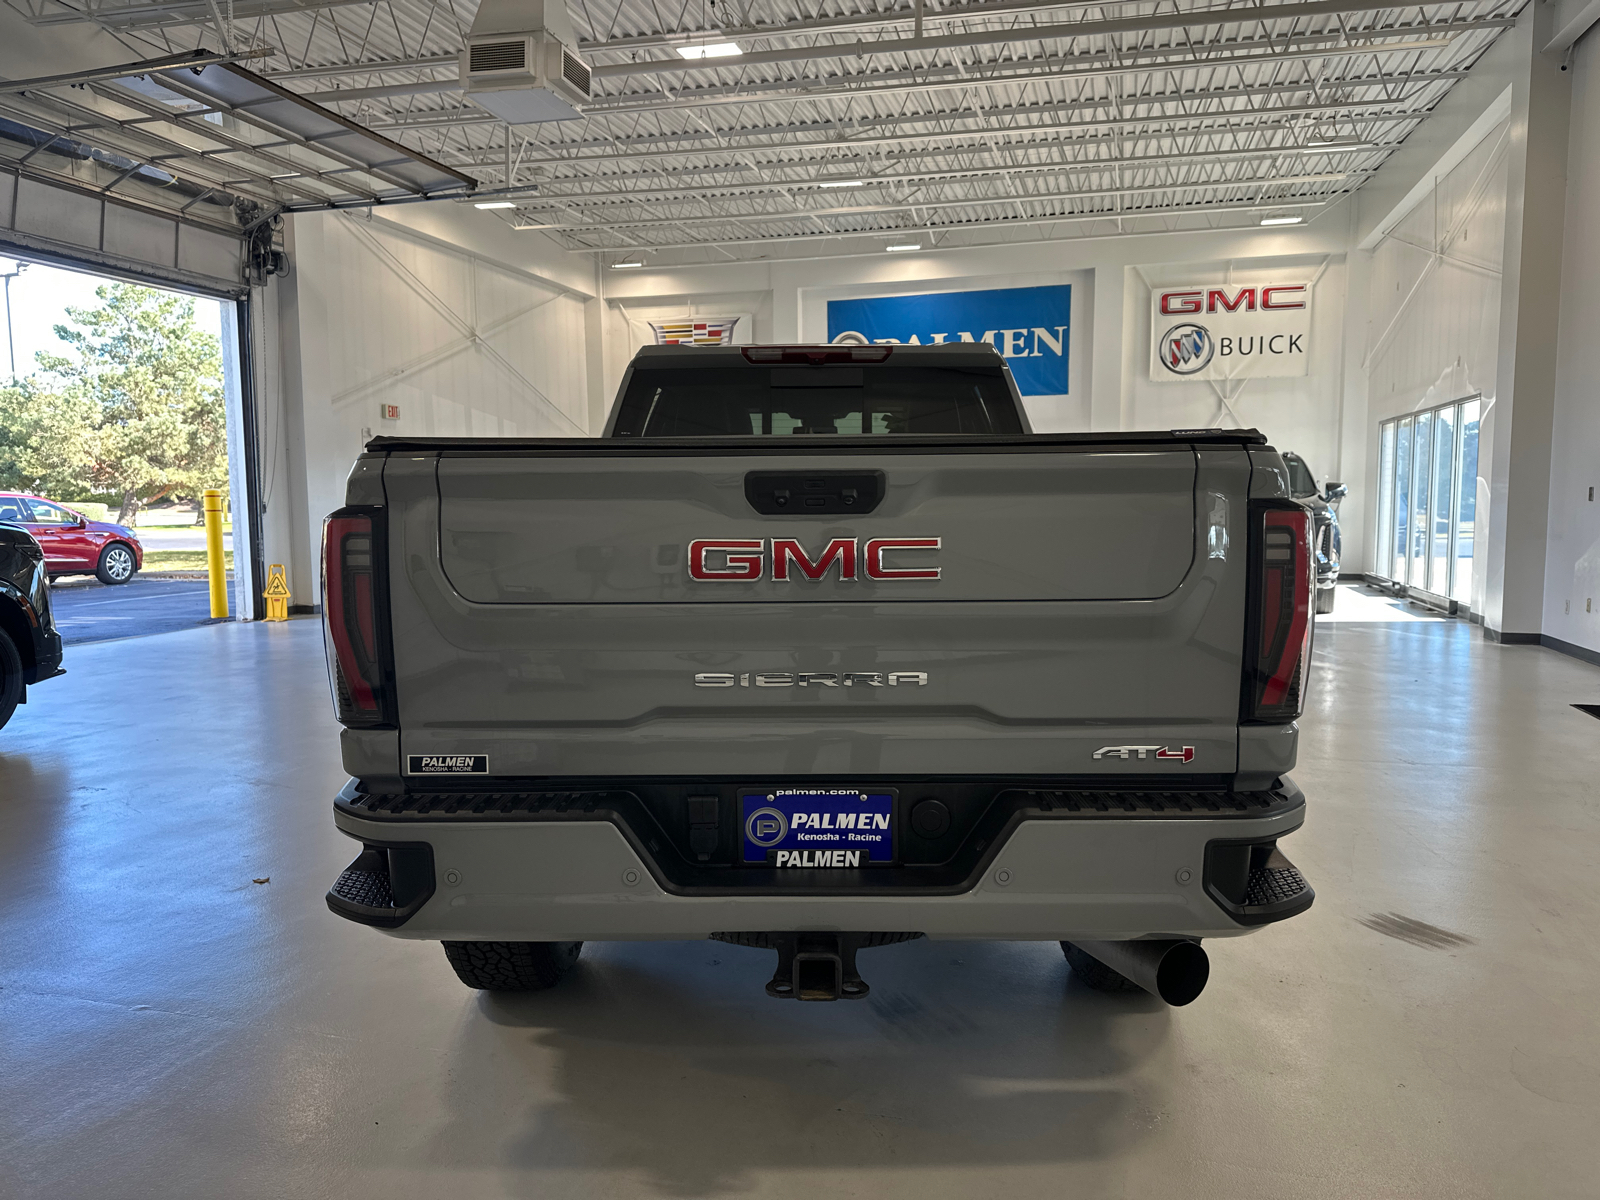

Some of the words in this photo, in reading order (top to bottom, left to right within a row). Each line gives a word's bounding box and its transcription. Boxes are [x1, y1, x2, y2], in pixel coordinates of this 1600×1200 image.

[1159, 284, 1307, 316] GMC
[1220, 334, 1303, 356] BUICK
[388, 405, 398, 418] EXIT
[688, 537, 942, 582] GMC
[694, 671, 928, 687] SIERRA
[421, 757, 474, 766] PALMEN
[1092, 745, 1195, 763] AT4
[757, 820, 780, 836] P
[791, 813, 890, 829] PALMEN
[797, 833, 840, 841] Kenosha
[848, 833, 882, 842] Racine
[776, 851, 860, 867] PALMEN
